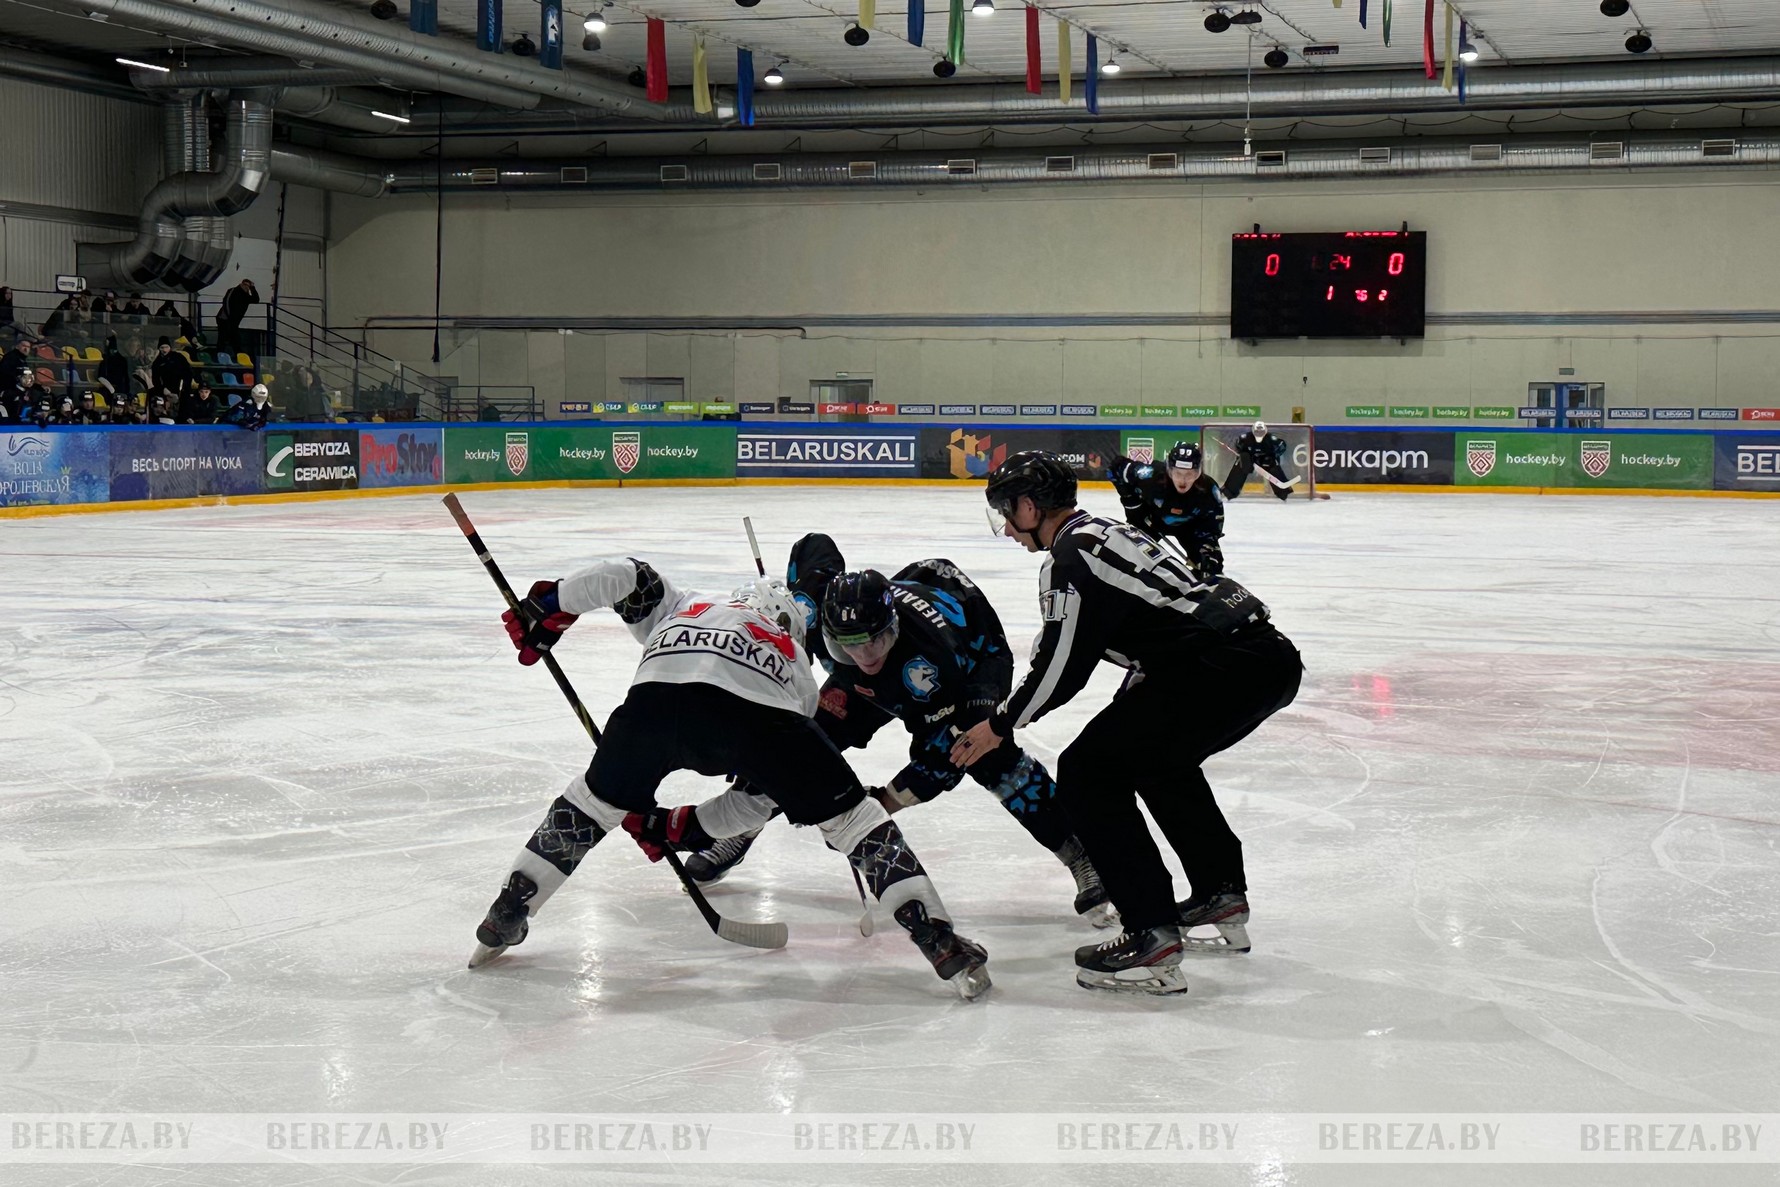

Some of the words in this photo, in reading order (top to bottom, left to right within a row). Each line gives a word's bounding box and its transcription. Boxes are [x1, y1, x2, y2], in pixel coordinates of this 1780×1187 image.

[1265, 253, 1280, 276] 0
[1388, 252, 1404, 275] 0
[294, 442, 351, 457] BERYOZA
[560, 447, 606, 460] hockey.by
[647, 446, 698, 459] hockey.by
[737, 441, 915, 461] BELARUSKALI
[132, 458, 159, 472] ВЕСЬ
[162, 457, 196, 471] СПОРТ
[199, 456, 213, 469] НА
[1293, 444, 1428, 475] белкарт
[1506, 453, 1567, 467] hockey.by
[1621, 454, 1681, 467] hockey.by
[294, 466, 358, 482] CERAMICA
